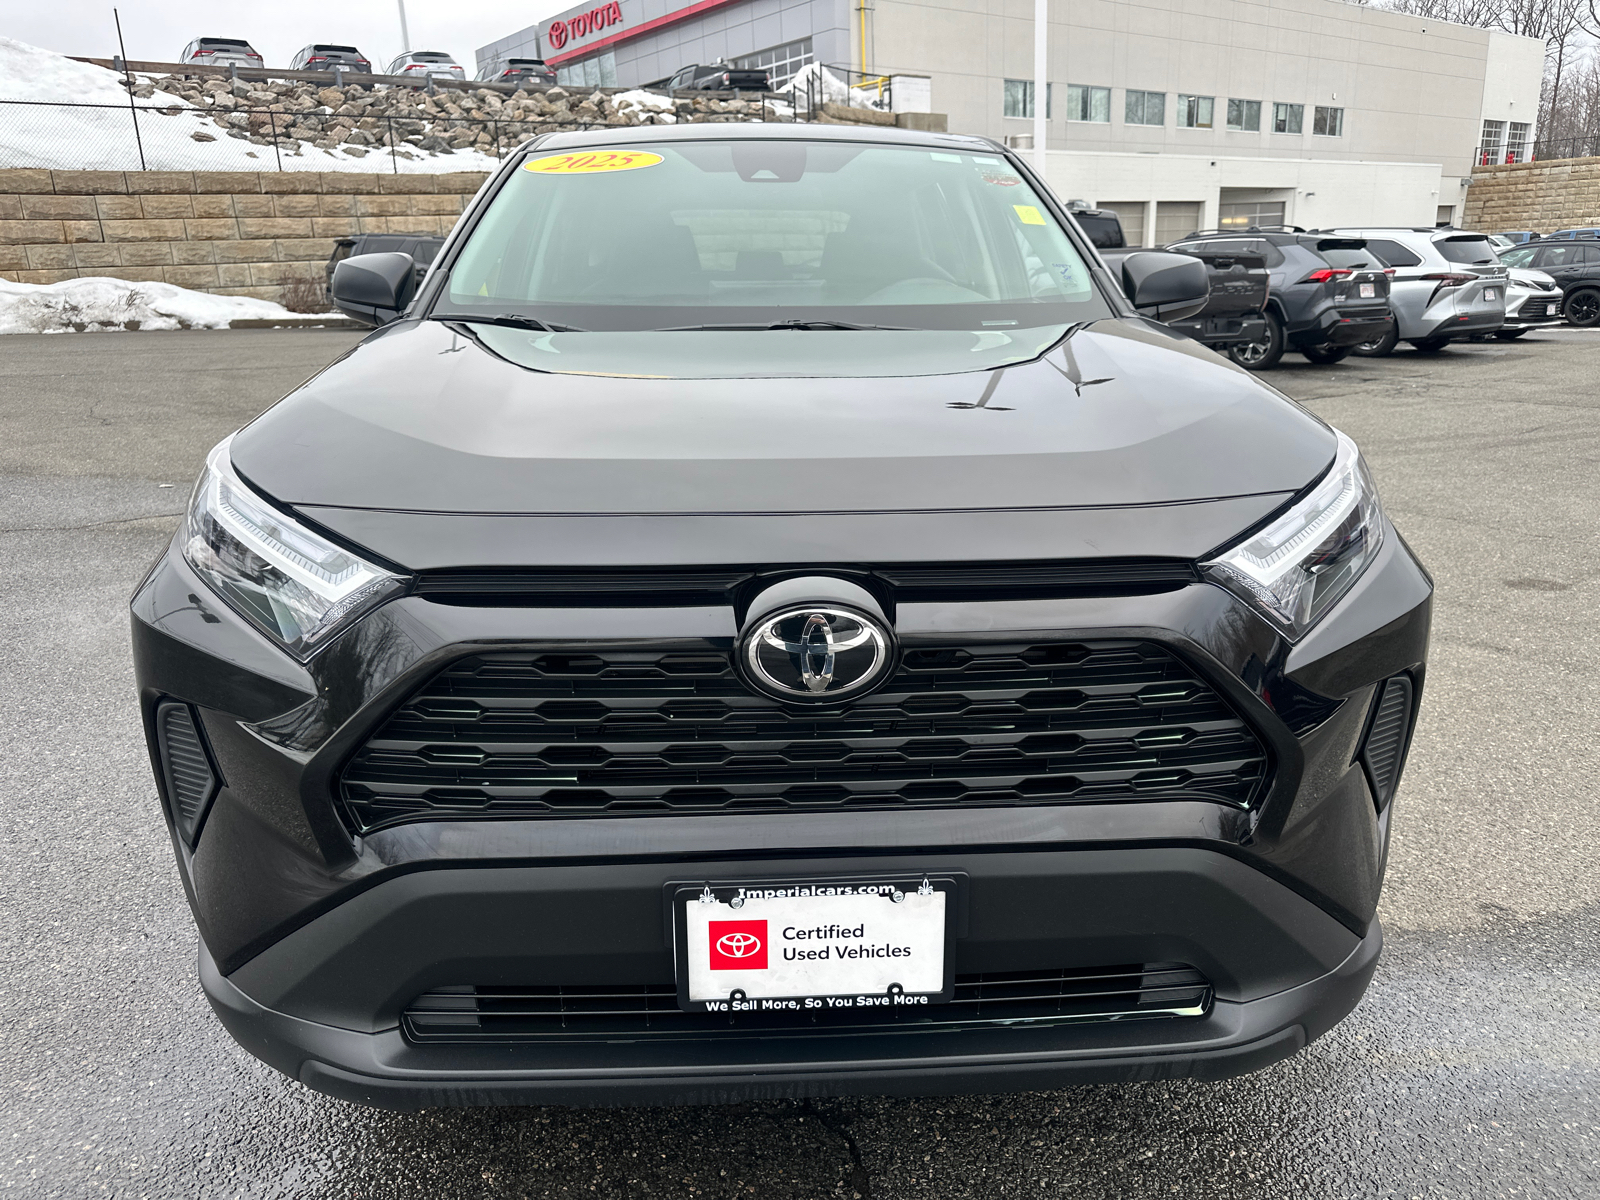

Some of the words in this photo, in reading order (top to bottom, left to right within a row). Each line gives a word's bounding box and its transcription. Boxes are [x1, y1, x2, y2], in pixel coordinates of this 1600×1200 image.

[567, 1, 622, 40] TOYOTA
[542, 154, 643, 171] 2025
[738, 884, 896, 900] Imperialcars.com
[782, 923, 865, 941] Certified
[783, 946, 830, 961] Used
[835, 944, 911, 959] Vehicles
[706, 1001, 728, 1012] We
[732, 1000, 757, 1010] Sell
[762, 999, 800, 1011] More,
[805, 998, 822, 1008] So
[827, 997, 852, 1007] You
[857, 996, 889, 1006] Save
[893, 995, 928, 1005] More
